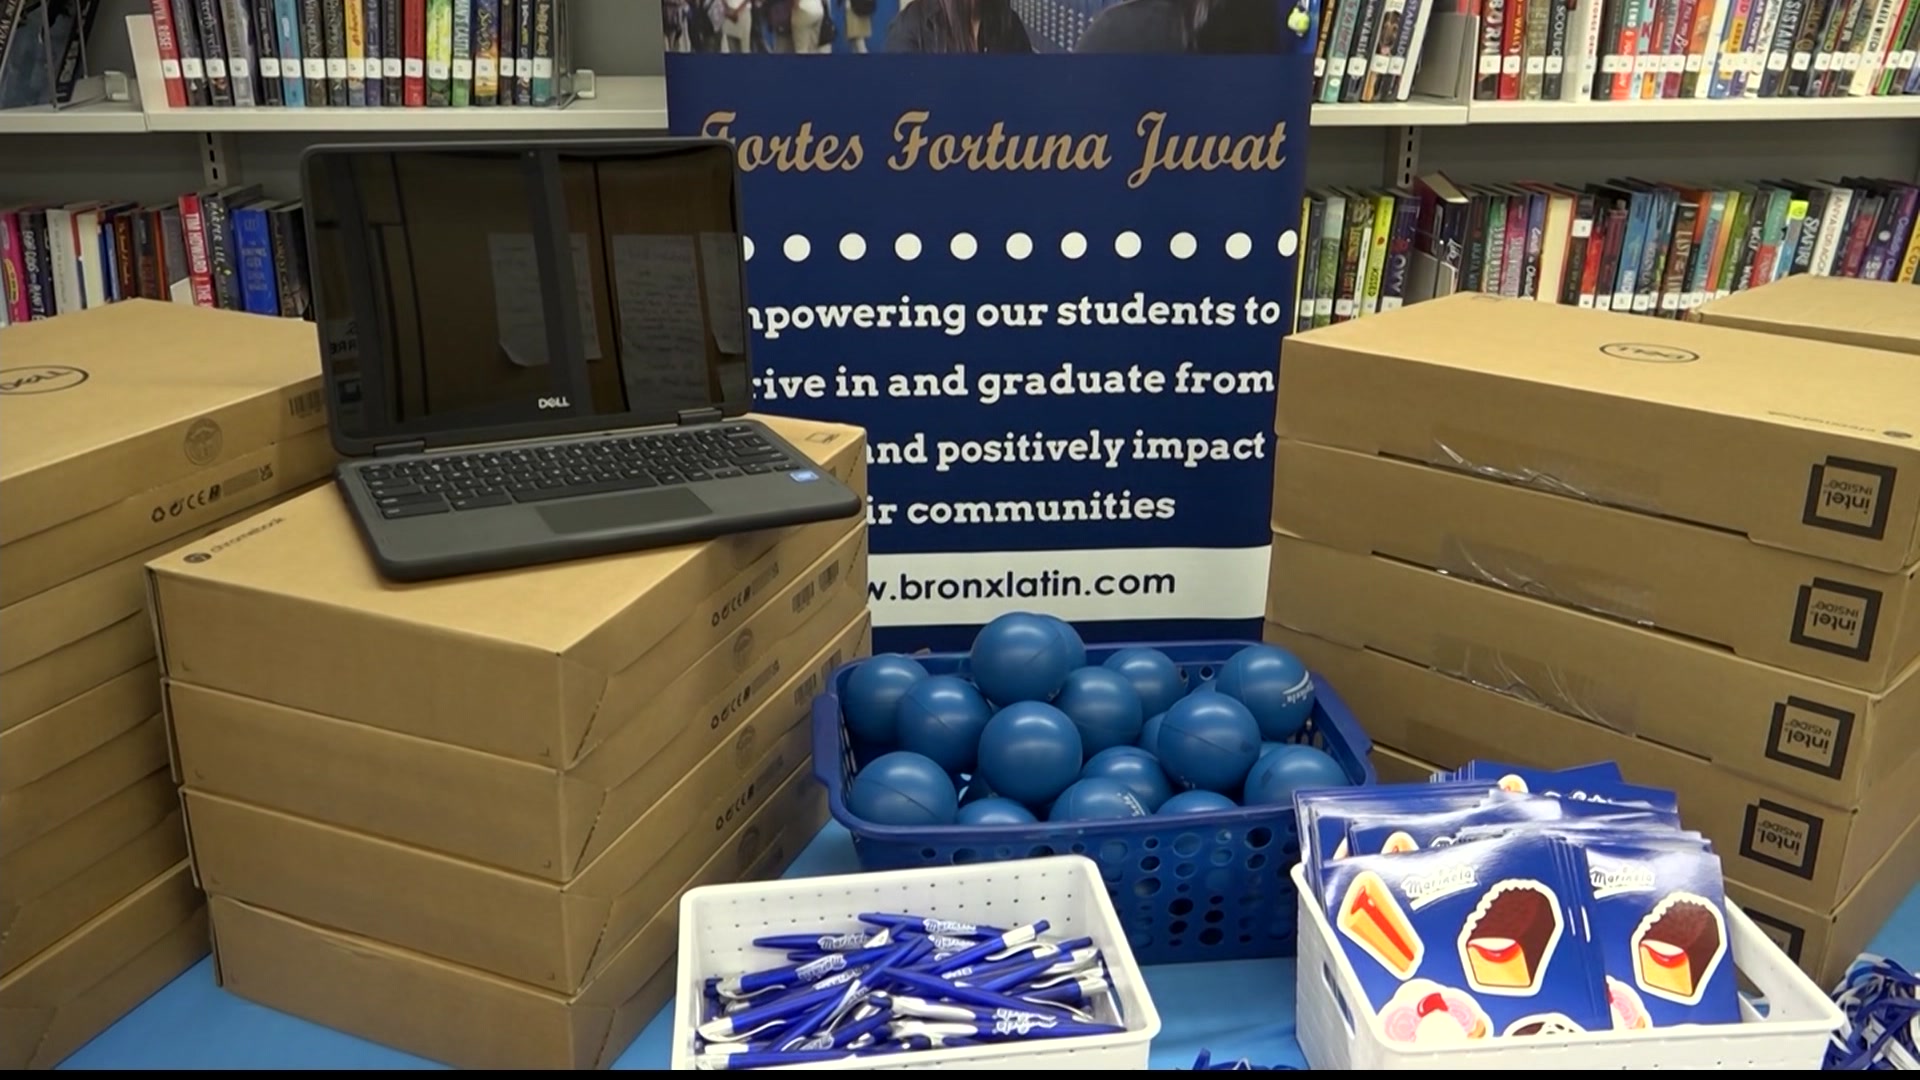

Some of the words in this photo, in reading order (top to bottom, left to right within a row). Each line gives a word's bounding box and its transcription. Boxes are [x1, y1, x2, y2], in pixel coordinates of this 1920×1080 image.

[887, 109, 1110, 172] Fortuna
[1127, 110, 1287, 188] Juvat
[190, 233, 208, 274] HOWARD
[977, 304, 1048, 327] our
[1057, 292, 1235, 326] students
[1245, 297, 1281, 326] to
[538, 396, 570, 409] DELL
[836, 366, 877, 396] in
[888, 364, 968, 397] and
[978, 363, 1165, 403] graduate
[1175, 362, 1274, 394] from
[936, 430, 1124, 471] positively
[1133, 430, 1265, 467] impact
[908, 490, 1175, 524] communities
